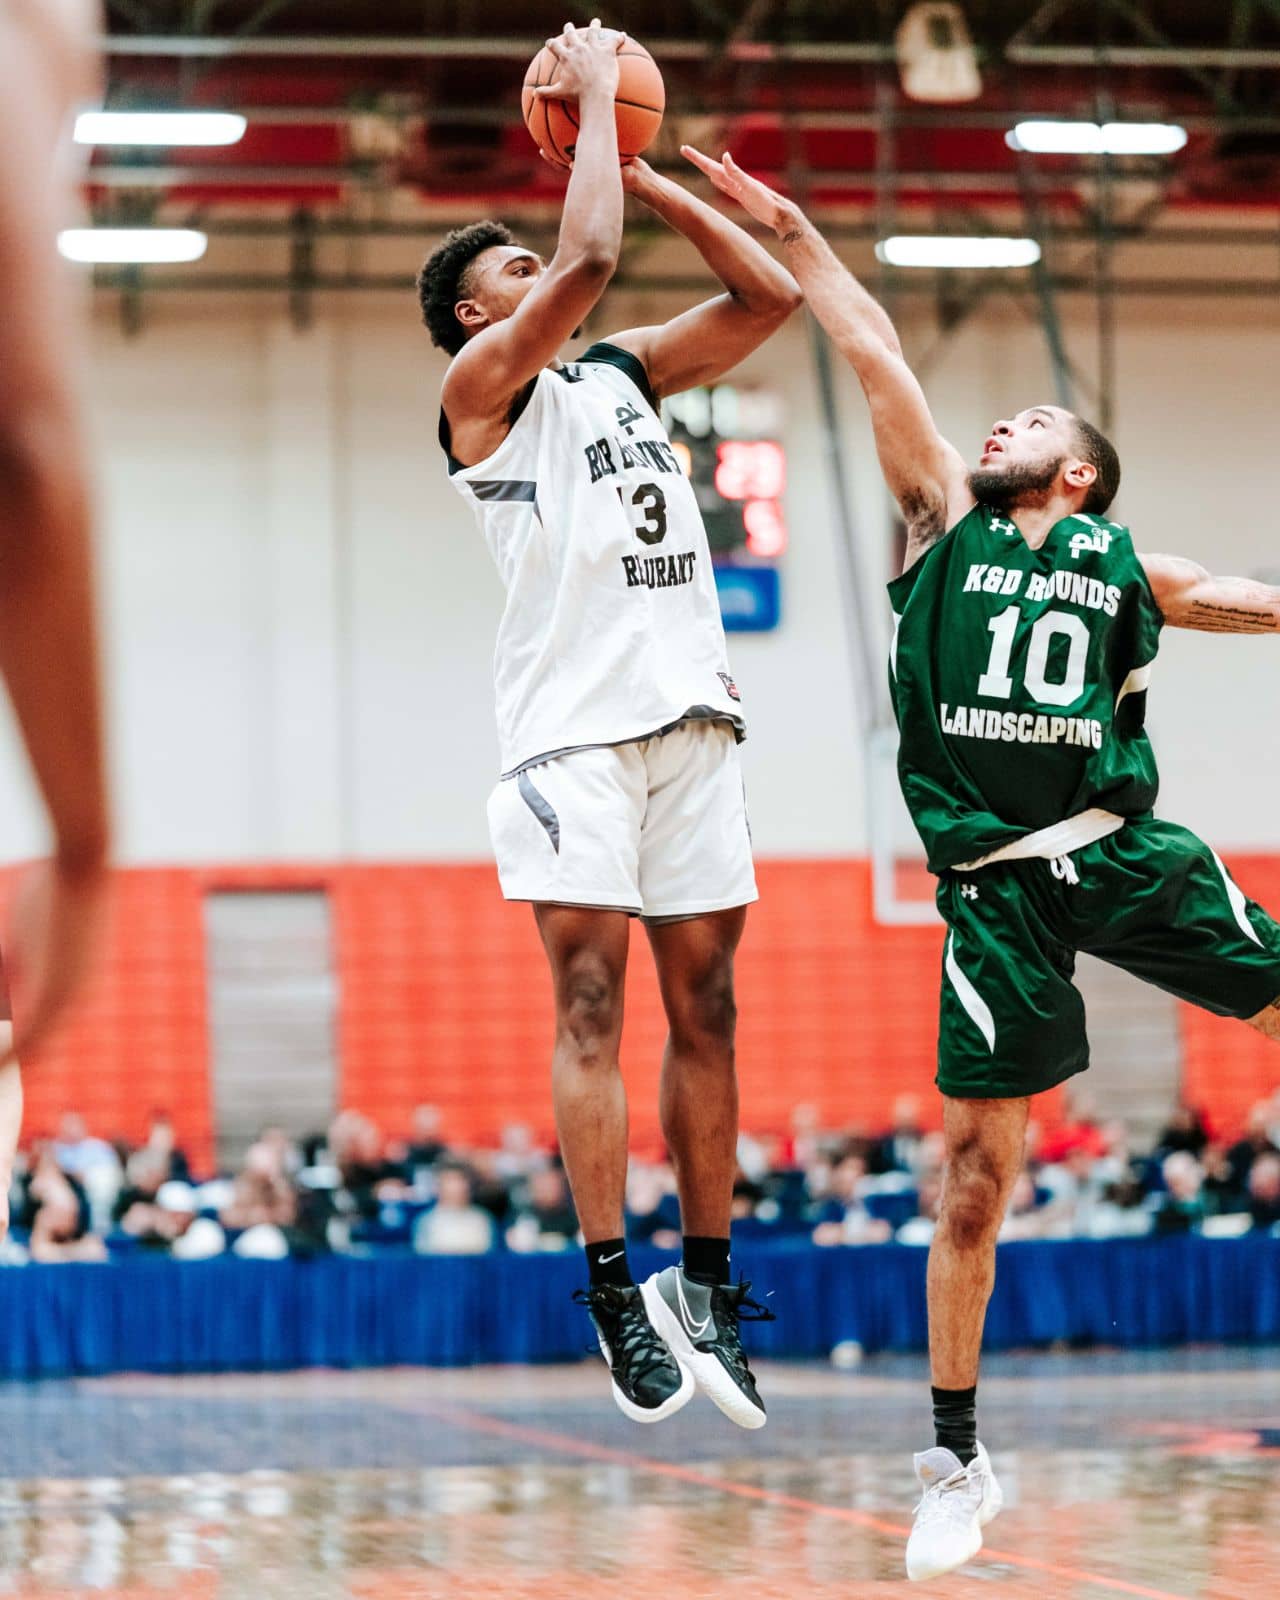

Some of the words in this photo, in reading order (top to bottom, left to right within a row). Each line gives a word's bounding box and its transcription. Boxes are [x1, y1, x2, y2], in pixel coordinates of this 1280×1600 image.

[616, 483, 667, 545] 3
[963, 564, 1023, 595] K&D
[977, 605, 1090, 706] 10
[940, 703, 1102, 750] LANDSCAPING
